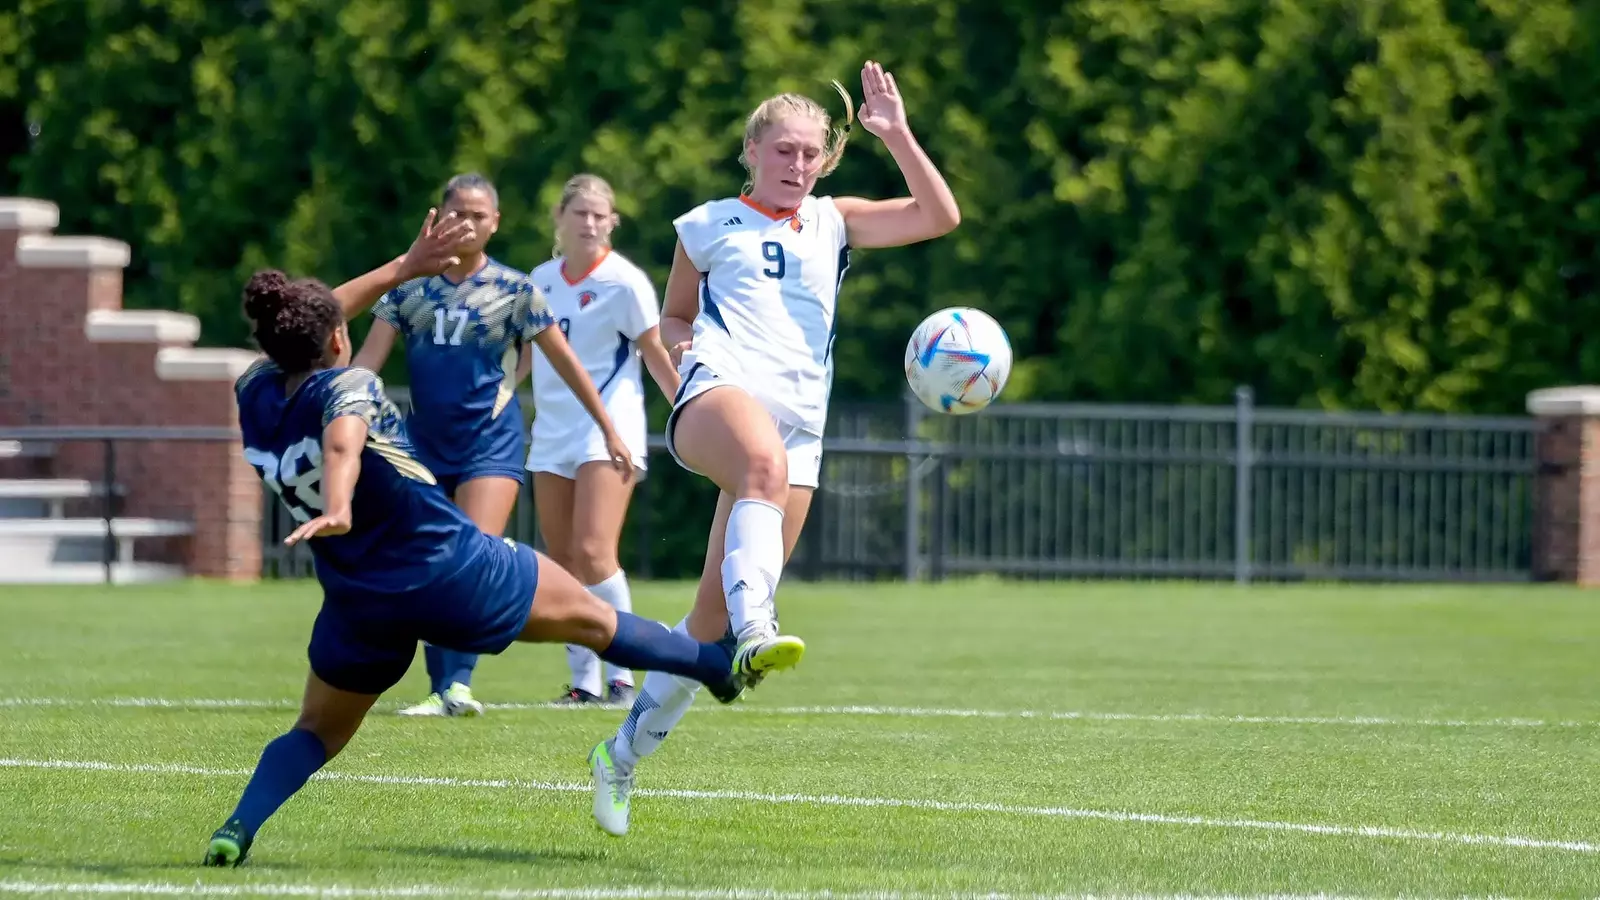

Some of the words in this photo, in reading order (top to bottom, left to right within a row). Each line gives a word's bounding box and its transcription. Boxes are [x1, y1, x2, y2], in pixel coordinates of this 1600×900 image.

[762, 241, 786, 280] 9
[433, 307, 469, 346] 17
[243, 436, 324, 523] 28
